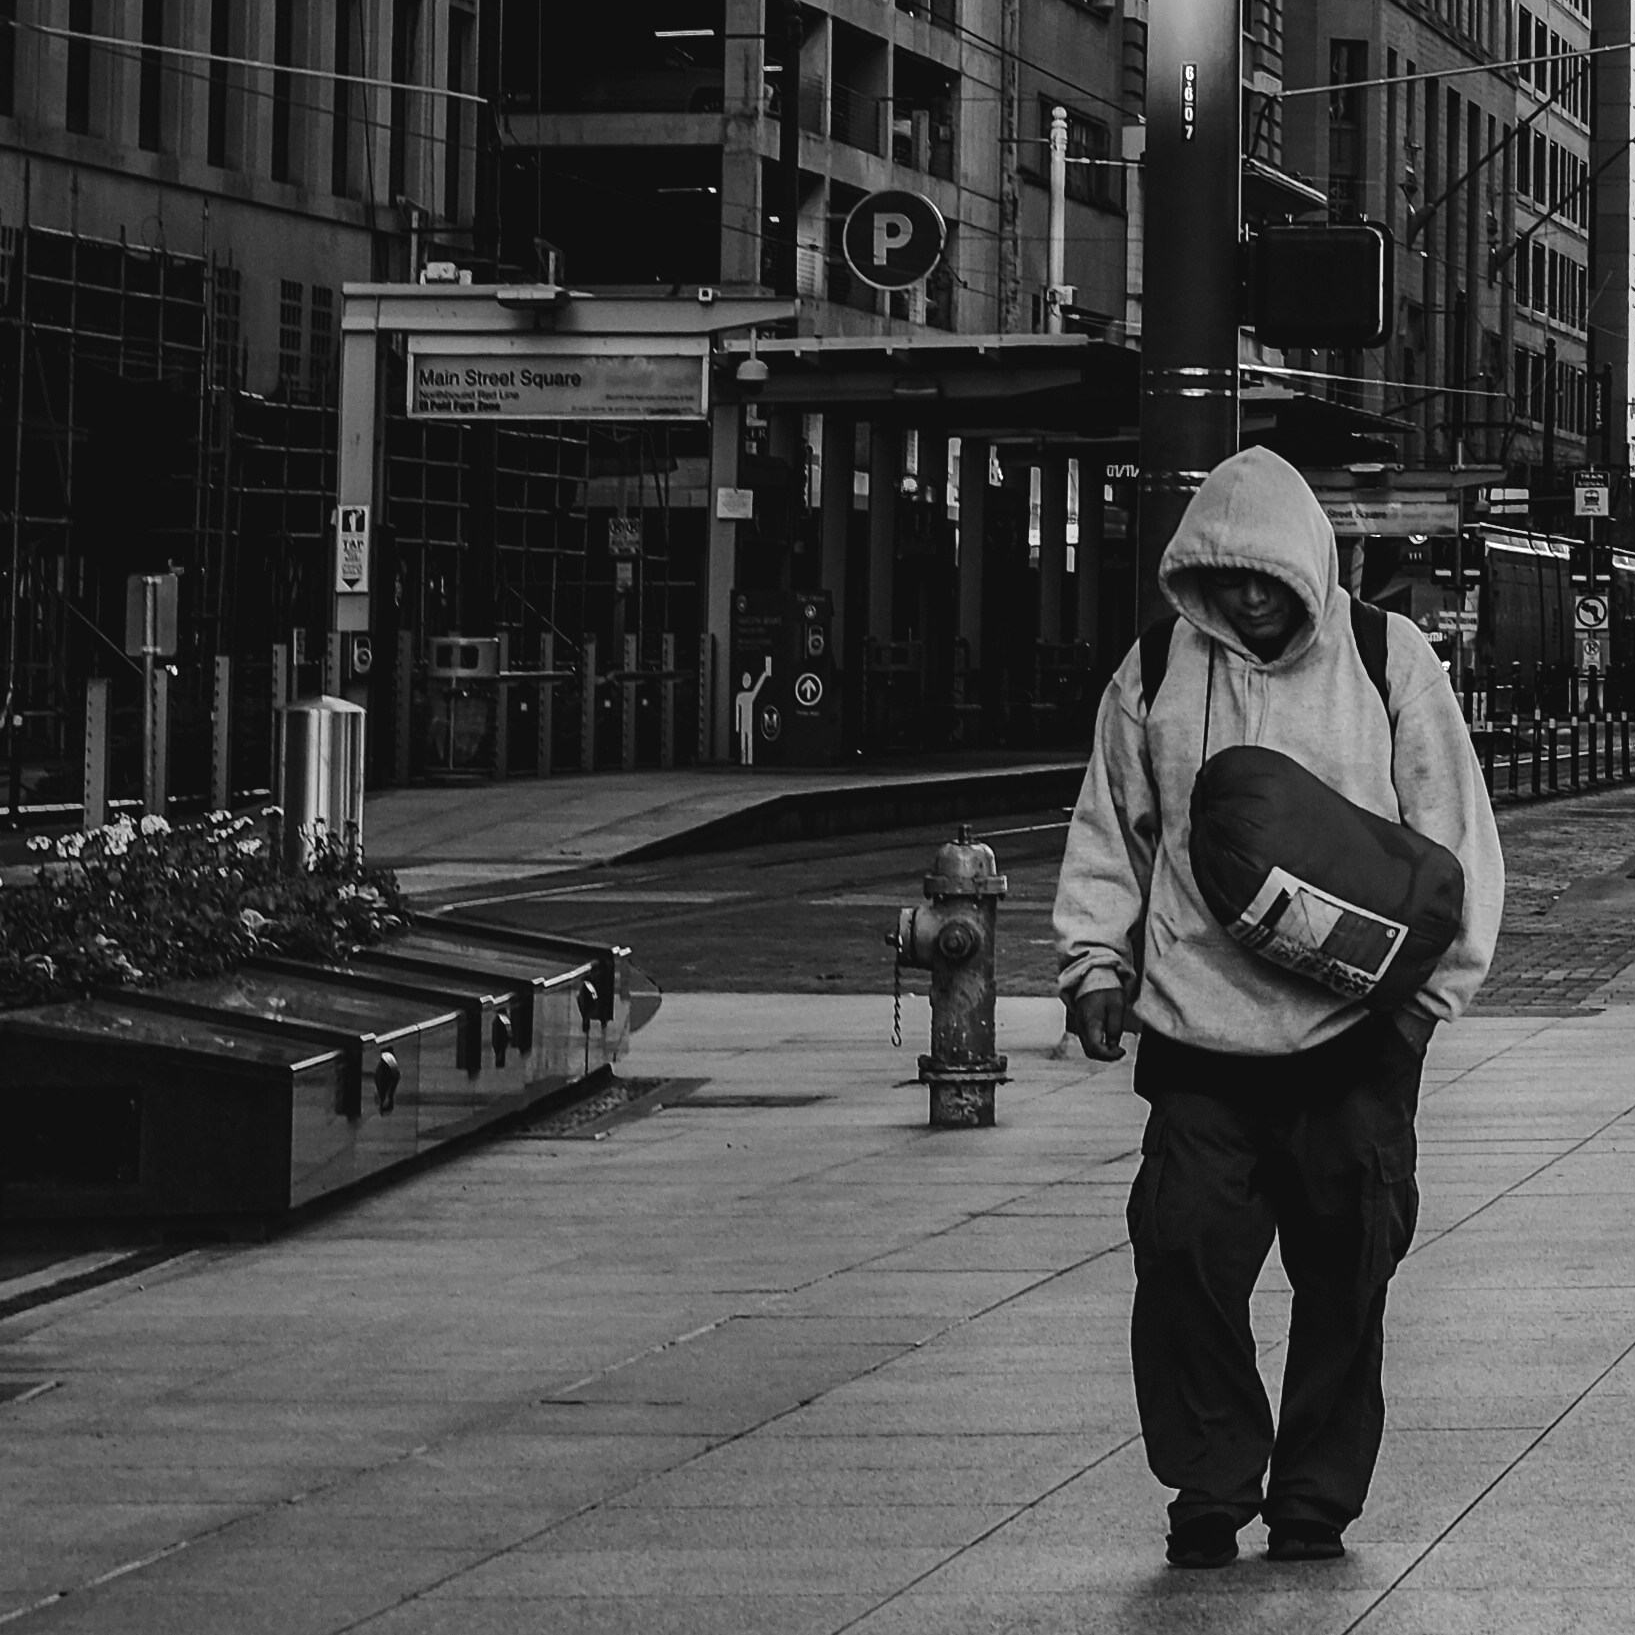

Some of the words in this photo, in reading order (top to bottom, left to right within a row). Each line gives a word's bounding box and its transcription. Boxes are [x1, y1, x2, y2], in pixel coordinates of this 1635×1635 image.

[418, 369, 460, 387] Main
[464, 369, 515, 387] Street
[520, 369, 582, 390] Square
